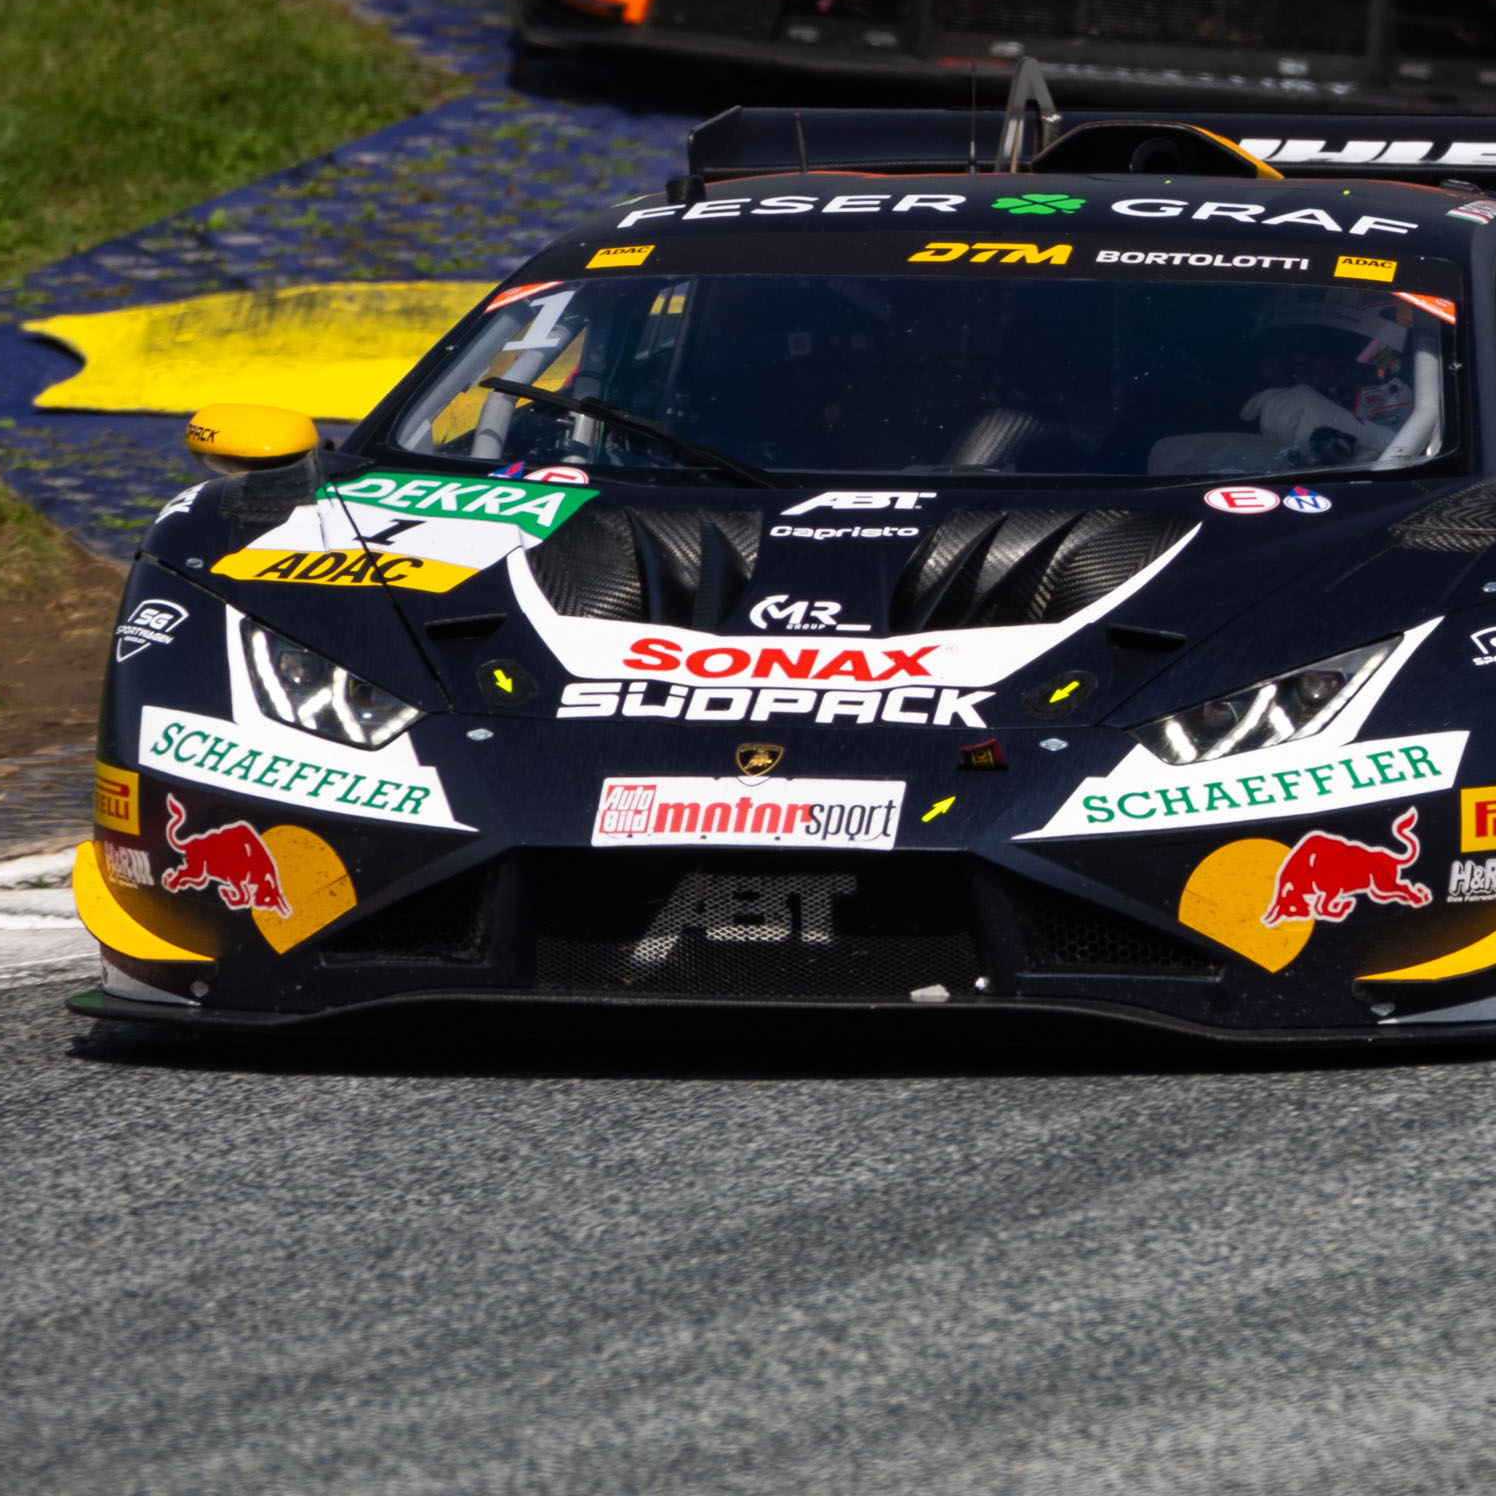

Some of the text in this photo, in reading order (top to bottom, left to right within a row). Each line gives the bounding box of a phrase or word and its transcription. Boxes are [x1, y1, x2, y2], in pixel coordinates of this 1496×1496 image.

[616, 193, 966, 229] FESER
[1110, 197, 1419, 236] GRAF
[598, 246, 652, 257] ADAC
[907, 242, 1309, 271] DTM BORTOLOTTI
[1340, 256, 1395, 270] ADAC
[327, 478, 567, 528] DEKRA
[780, 491, 938, 516] ABT
[1220, 489, 1266, 509] E
[353, 518, 427, 546] 1
[769, 525, 920, 541] Capristo
[253, 552, 424, 584] ADAC
[133, 607, 175, 629] SG
[785, 622, 826, 631] GROUP
[115, 624, 175, 645] SPORTWAGEN
[622, 637, 942, 682] SONAX
[556, 681, 997, 728] SÜDPACK
[150, 722, 432, 816] SCHAEFFLER
[606, 786, 655, 810] Auto
[1082, 744, 1442, 824] SCHAEFFLER
[603, 809, 647, 832] Bild
[653, 797, 896, 841] motorsport
[630, 872, 857, 963] ABT
